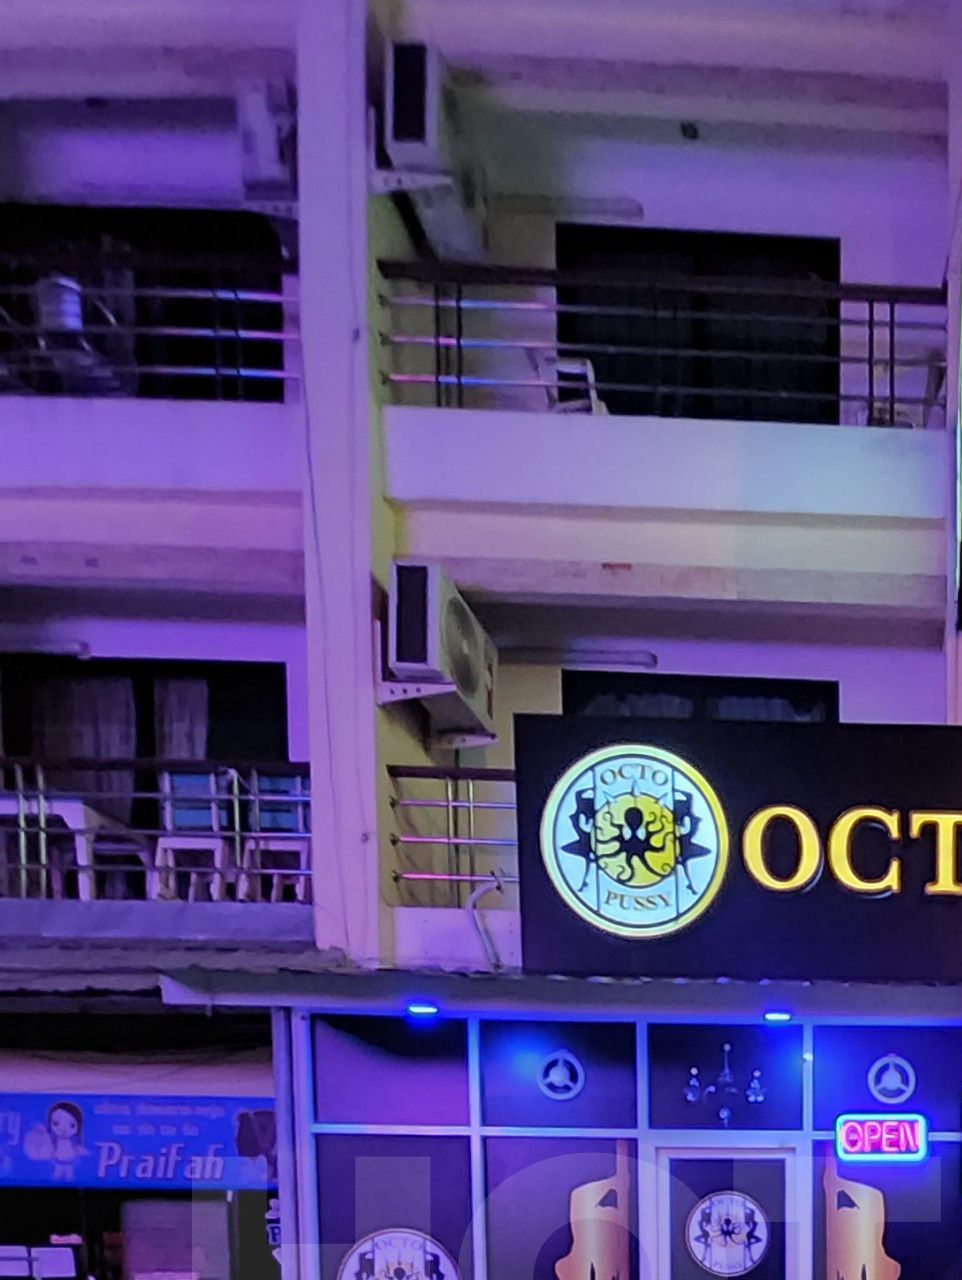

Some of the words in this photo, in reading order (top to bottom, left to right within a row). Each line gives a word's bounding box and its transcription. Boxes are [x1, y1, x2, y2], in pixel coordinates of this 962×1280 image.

[600, 763, 669, 787] OCTO
[604, 889, 673, 912] PUSSY
[842, 1120, 920, 1152] OPEN
